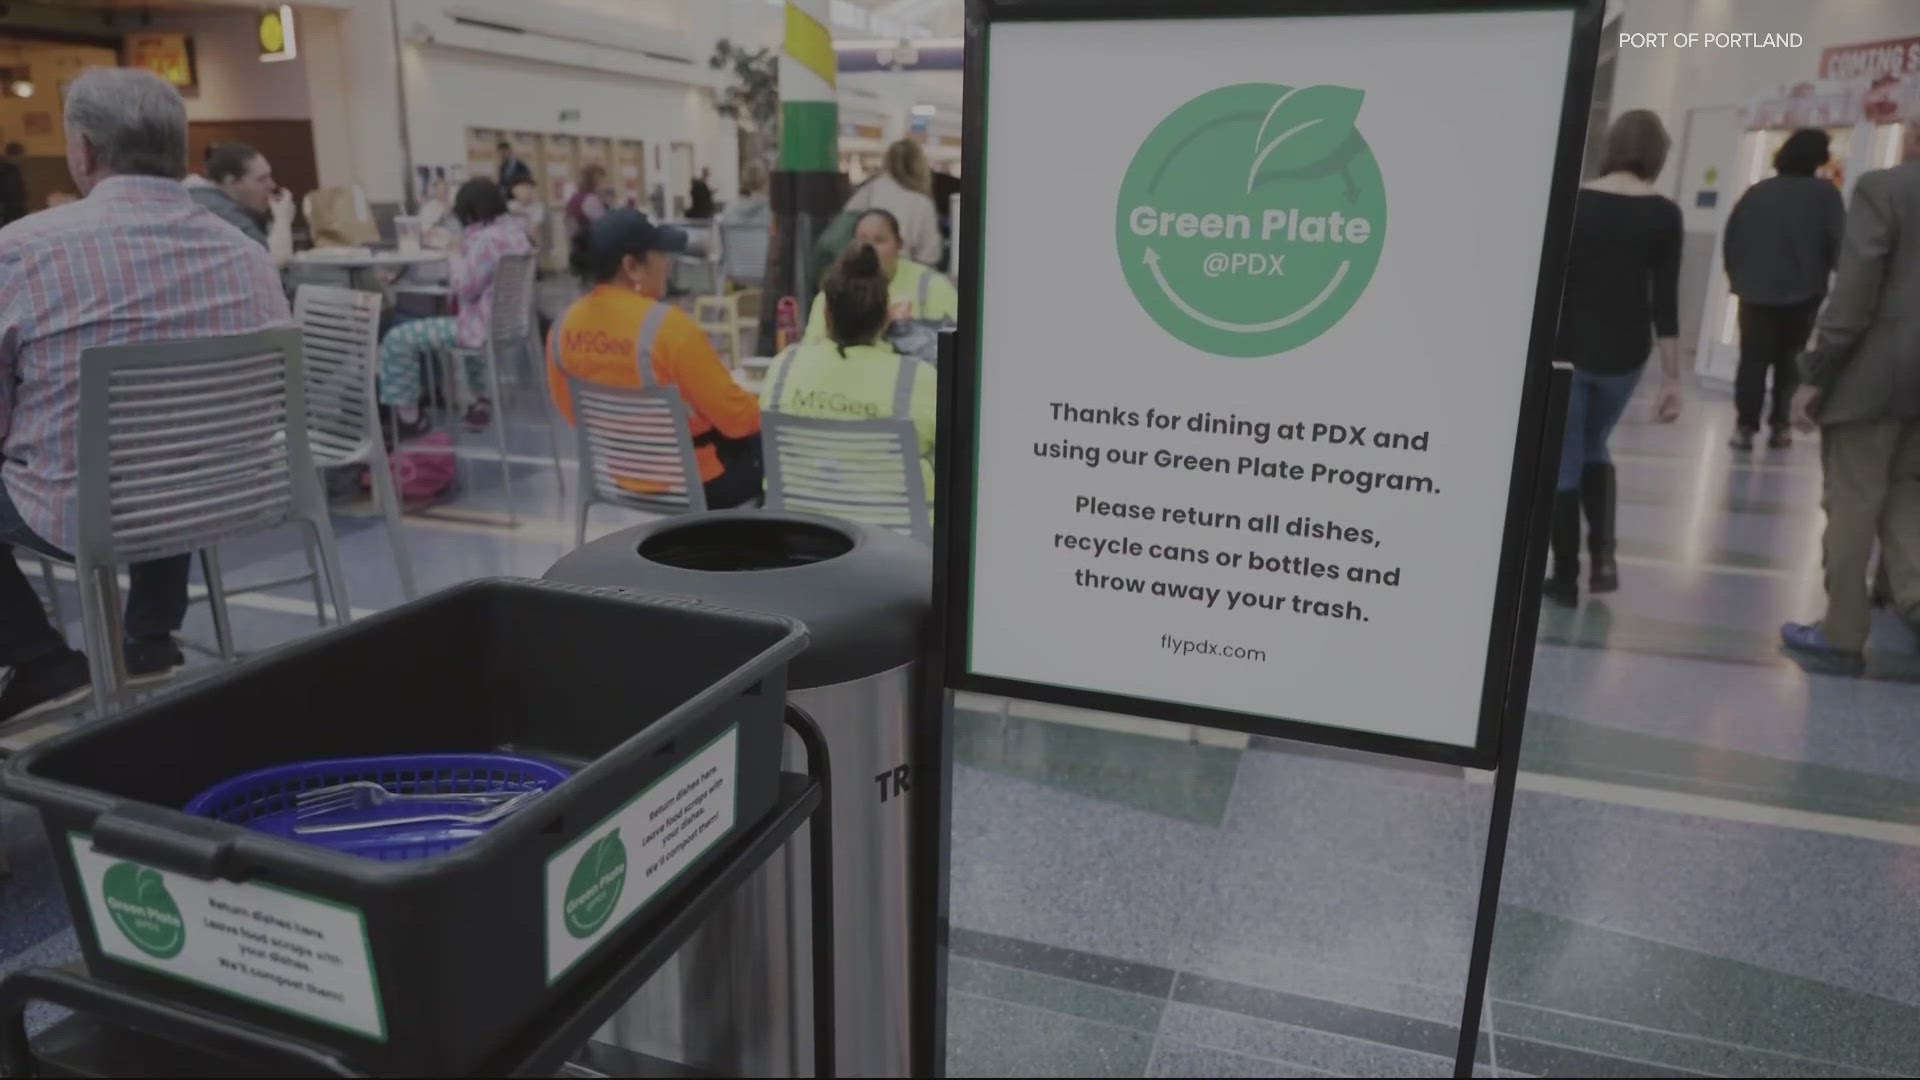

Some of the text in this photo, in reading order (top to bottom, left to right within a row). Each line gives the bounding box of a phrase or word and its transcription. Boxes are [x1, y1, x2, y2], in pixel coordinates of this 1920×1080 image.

[1129, 205, 1372, 244] Green Plate
[1203, 252, 1286, 277] @PDX
[1050, 402, 1429, 452] Thanks for dining at PDX and
[1033, 439, 1441, 494] using our Green Plate Program.
[1075, 495, 1381, 548] Please return all dishes,
[1054, 533, 1401, 587] recycle cans or bottles and
[1075, 569, 1369, 622] throw away your trash.
[1161, 633, 1266, 662] flypdx.com
[642, 778, 723, 848] Leave food scraps with
[649, 796, 675, 821] Return
[676, 778, 700, 801] dishes
[662, 826, 679, 847] your
[666, 828, 698, 861] compost
[566, 864, 625, 914] Green Plate
[107, 896, 181, 927] Green Plate
[203, 917, 239, 936] Leave
[240, 926, 268, 944] food
[208, 898, 250, 917] Return
[252, 910, 292, 931] dishes
[250, 967, 304, 990] compost
